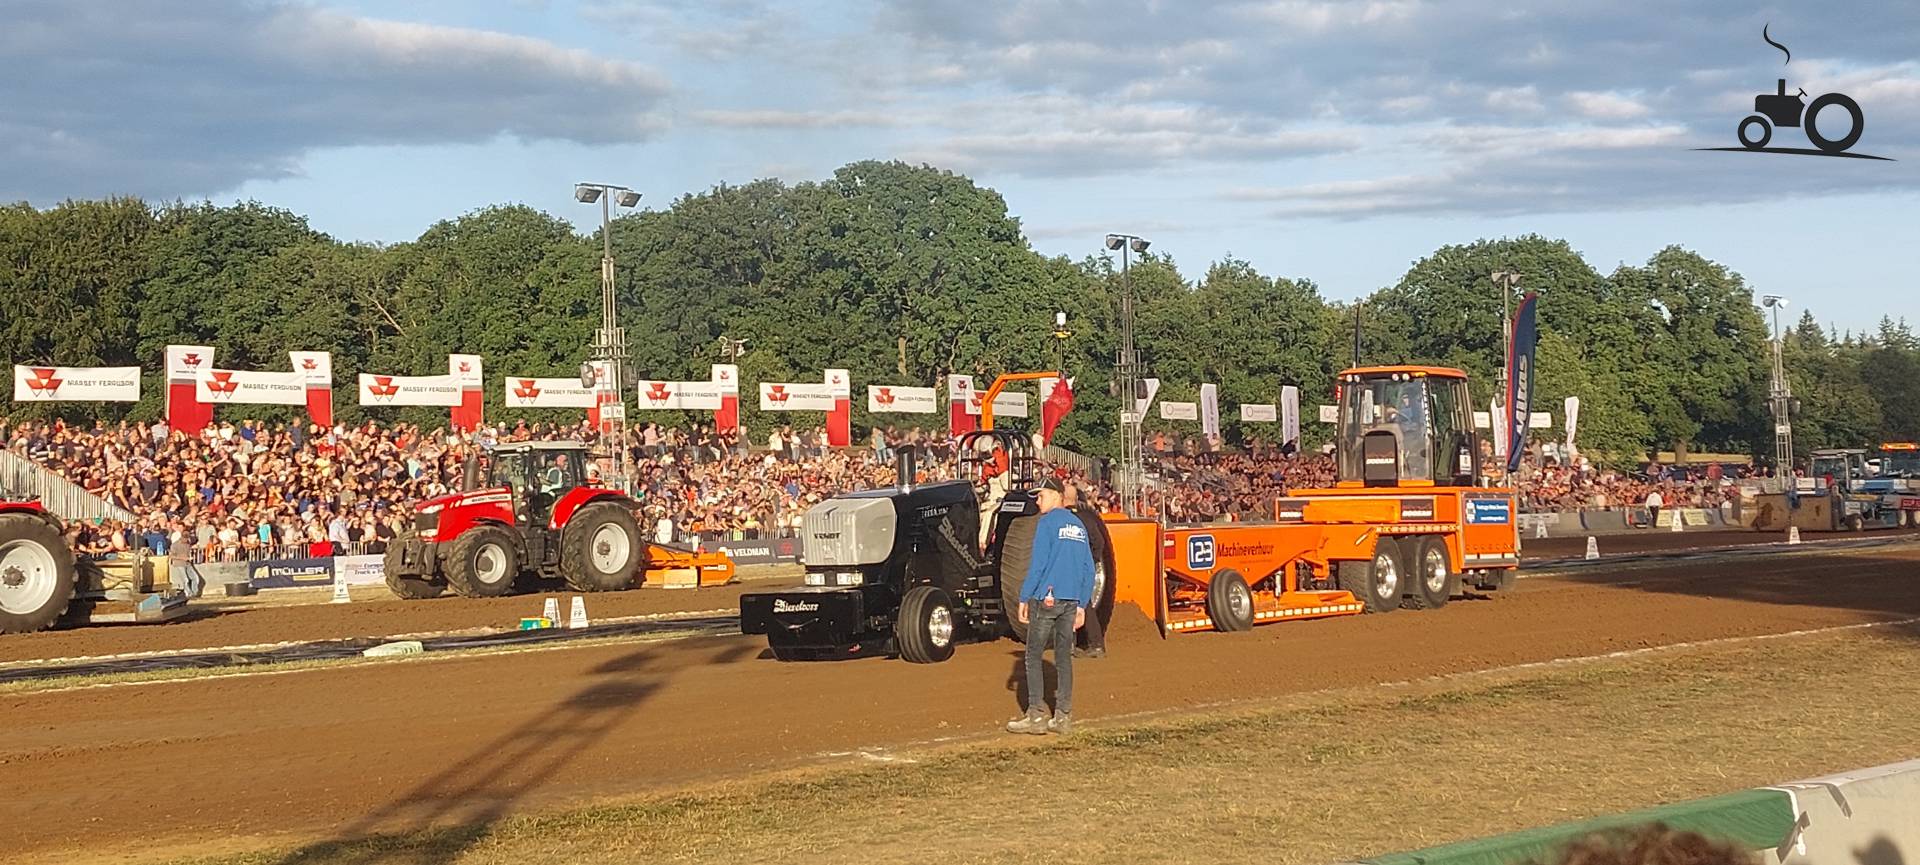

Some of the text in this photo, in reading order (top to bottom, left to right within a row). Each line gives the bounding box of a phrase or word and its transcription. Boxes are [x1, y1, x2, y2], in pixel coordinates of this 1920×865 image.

[99, 379, 134, 387] FERGUSON
[814, 532, 841, 540] FENDT
[733, 547, 770, 557] VELDMAN
[1190, 541, 1213, 563] 123
